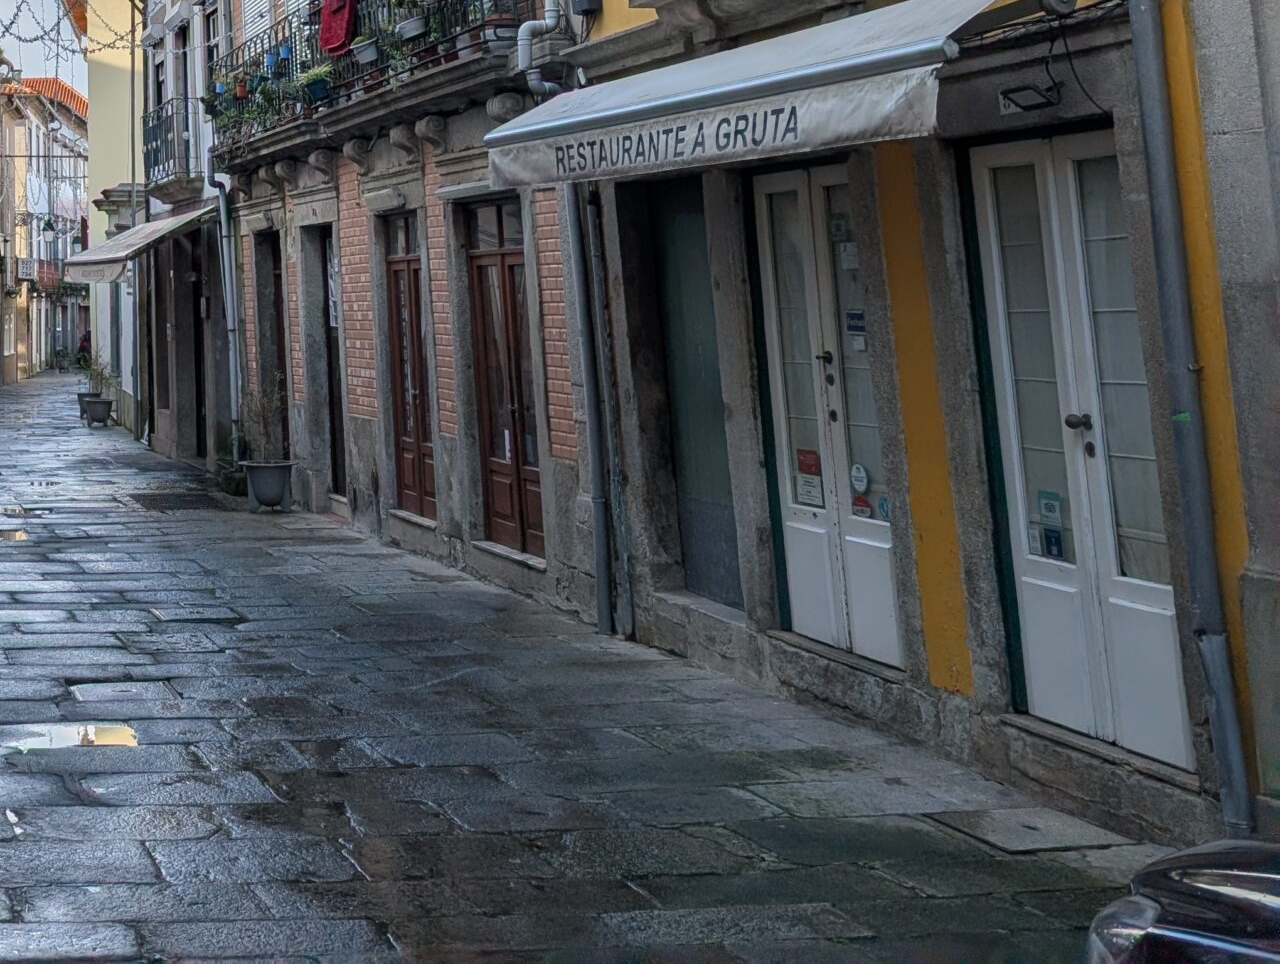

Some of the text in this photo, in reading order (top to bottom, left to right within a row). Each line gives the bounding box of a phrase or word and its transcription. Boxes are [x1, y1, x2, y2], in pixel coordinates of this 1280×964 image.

[555, 105, 799, 175] RESTAURANTE A GRUTA
